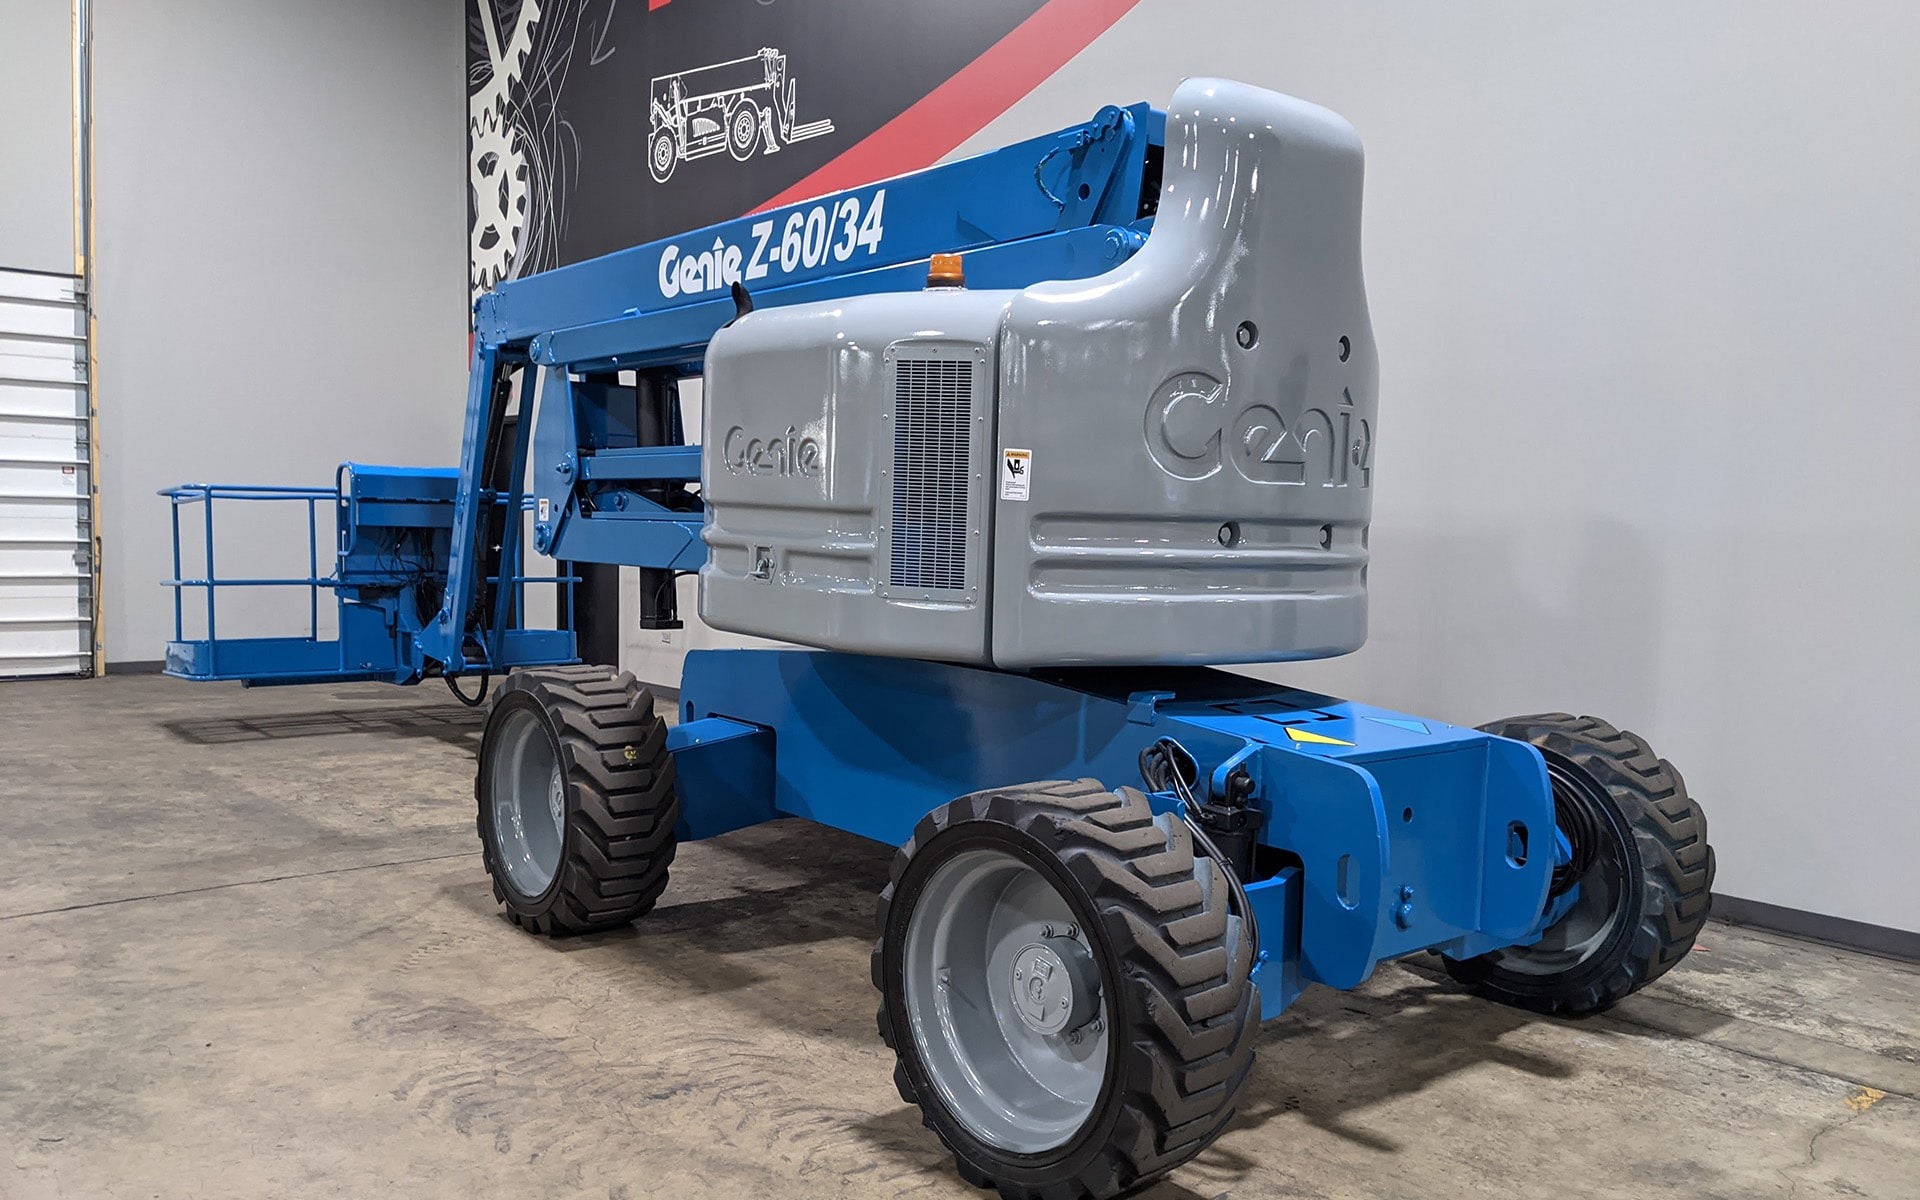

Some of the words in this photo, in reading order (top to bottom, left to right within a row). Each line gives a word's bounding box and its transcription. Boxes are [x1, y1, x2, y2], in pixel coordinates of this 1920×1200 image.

[658, 235, 743, 299] Genie
[744, 189, 886, 281] Z-60/34
[722, 424, 819, 479] Genie
[1142, 370, 1371, 489] Genie
